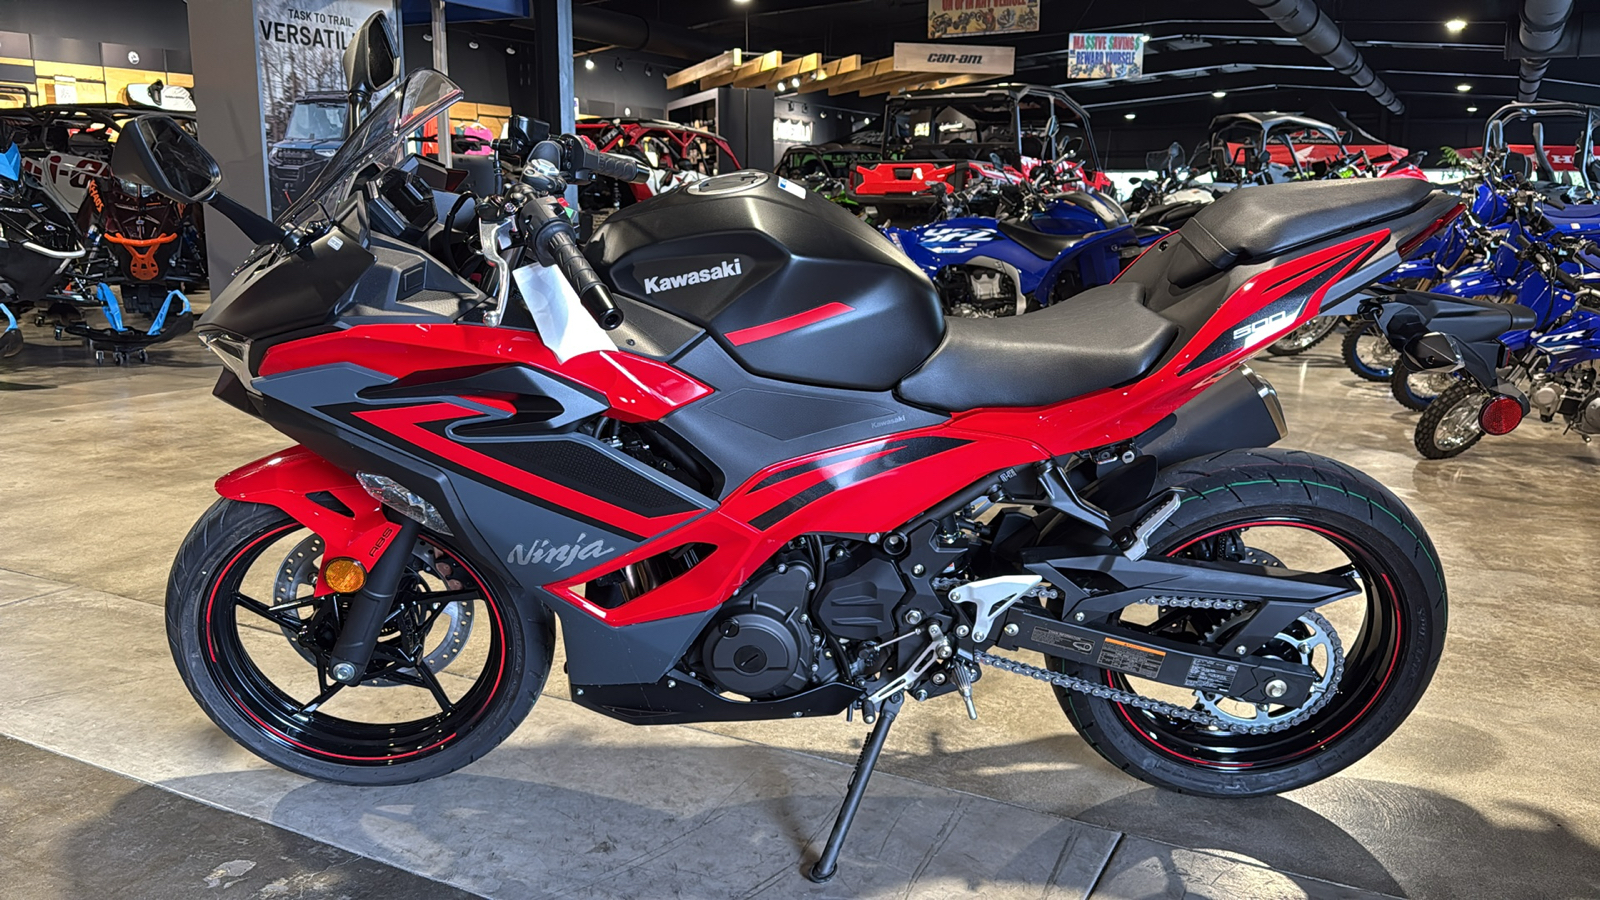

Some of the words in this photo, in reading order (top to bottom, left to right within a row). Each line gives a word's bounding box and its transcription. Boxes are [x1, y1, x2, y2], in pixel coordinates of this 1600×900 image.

[288, 9, 312, 21] TASK
[314, 12, 326, 24] TO
[328, 15, 354, 27] TRAIL
[259, 20, 355, 50] VERSATIL
[927, 53, 983, 64] can-am
[1076, 51, 1104, 65] REWARD
[1105, 51, 1136, 65] YOURSELF
[643, 258, 742, 295] Kawasaki
[1233, 310, 1287, 340] 500
[871, 415, 906, 429] Kawasaki
[369, 527, 394, 557] ABS
[507, 533, 615, 572] Ninja
